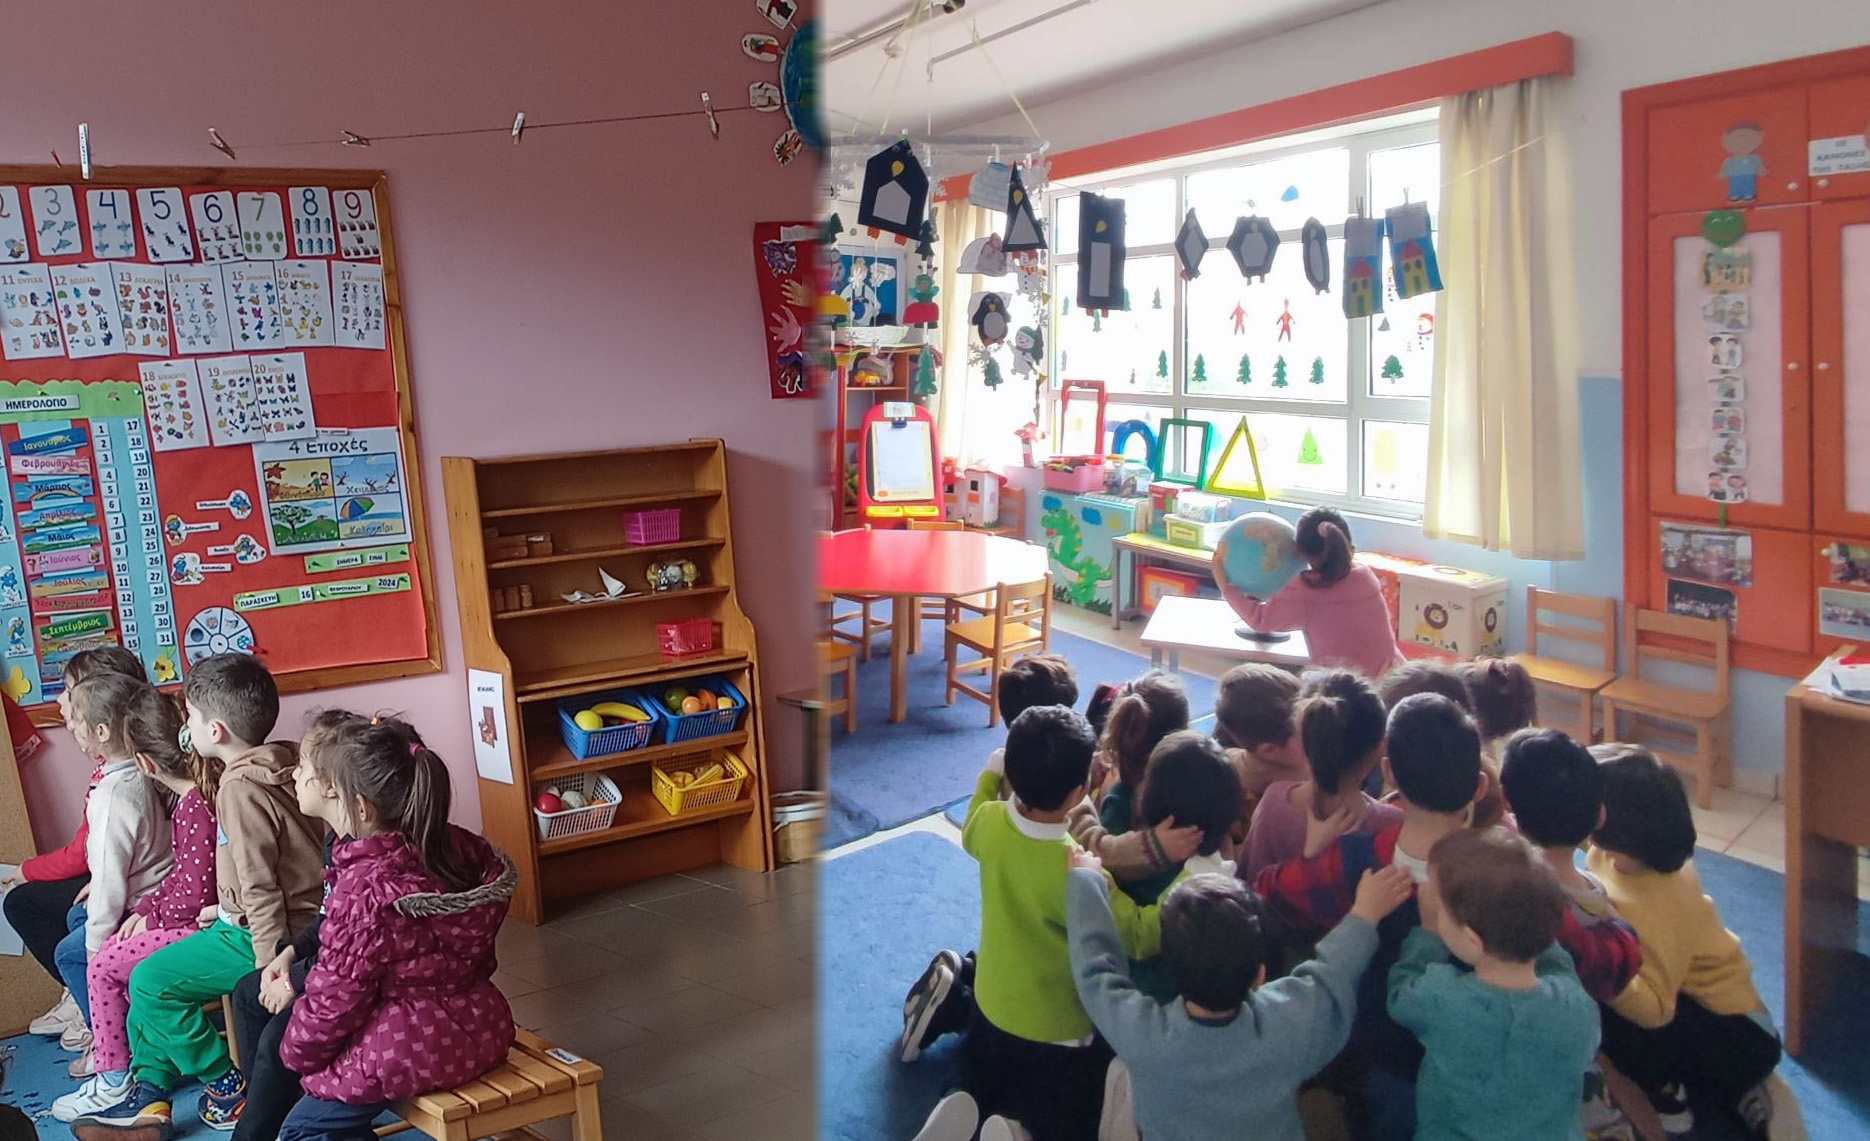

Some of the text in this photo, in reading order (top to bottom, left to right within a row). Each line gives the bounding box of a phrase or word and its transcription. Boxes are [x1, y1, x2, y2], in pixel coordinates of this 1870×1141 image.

[44, 188, 62, 216] 3
[98, 191, 117, 219] 4
[149, 190, 171, 220] 5
[302, 188, 319, 216] 8
[344, 191, 362, 219] 9
[203, 194, 223, 223] 6
[251, 197, 266, 222] 7
[119, 272, 133, 282] 13
[168, 273, 182, 283] 14
[232, 271, 245, 281] 15
[277, 268, 290, 279] 16
[341, 271, 353, 281] 17
[2, 275, 16, 286] 11
[53, 275, 68, 286] 12
[208, 367, 220, 377] 19
[253, 364, 267, 375] 20
[142, 371, 156, 382] 18
[98, 425, 105, 433] 1
[127, 421, 138, 431] 17
[101, 440, 108, 448] 2
[131, 438, 142, 446] 18
[289, 441, 300, 455] 4
[103, 454, 109, 463] 3
[134, 453, 145, 461] 19
[106, 470, 113, 480] 4
[137, 468, 148, 477] 20
[107, 486, 114, 495] 5
[138, 482, 149, 491] 21
[109, 500, 115, 509] 6
[140, 497, 151, 506] 22
[113, 516, 120, 525] 7
[142, 513, 153, 522] 23
[115, 532, 121, 540] 8
[145, 528, 156, 537] 24
[145, 541, 156, 550] 25
[115, 547, 122, 556] 9
[149, 556, 160, 565] 26
[116, 563, 127, 572] 10
[150, 572, 160, 581] 27
[119, 578, 129, 587] 11
[153, 586, 164, 595] 28
[240, 594, 277, 607] ΠΑΡΑΣΚΕΥΗ
[301, 590, 311, 600] 16
[378, 577, 396, 588] 2024
[122, 593, 132, 602] 12
[154, 603, 165, 612] 29
[123, 608, 133, 617] 13
[49, 618, 102, 635] Σεπτέμβριος
[157, 618, 168, 626] 30
[125, 624, 136, 633] 14
[160, 634, 171, 642] 31
[128, 639, 138, 648] 15
